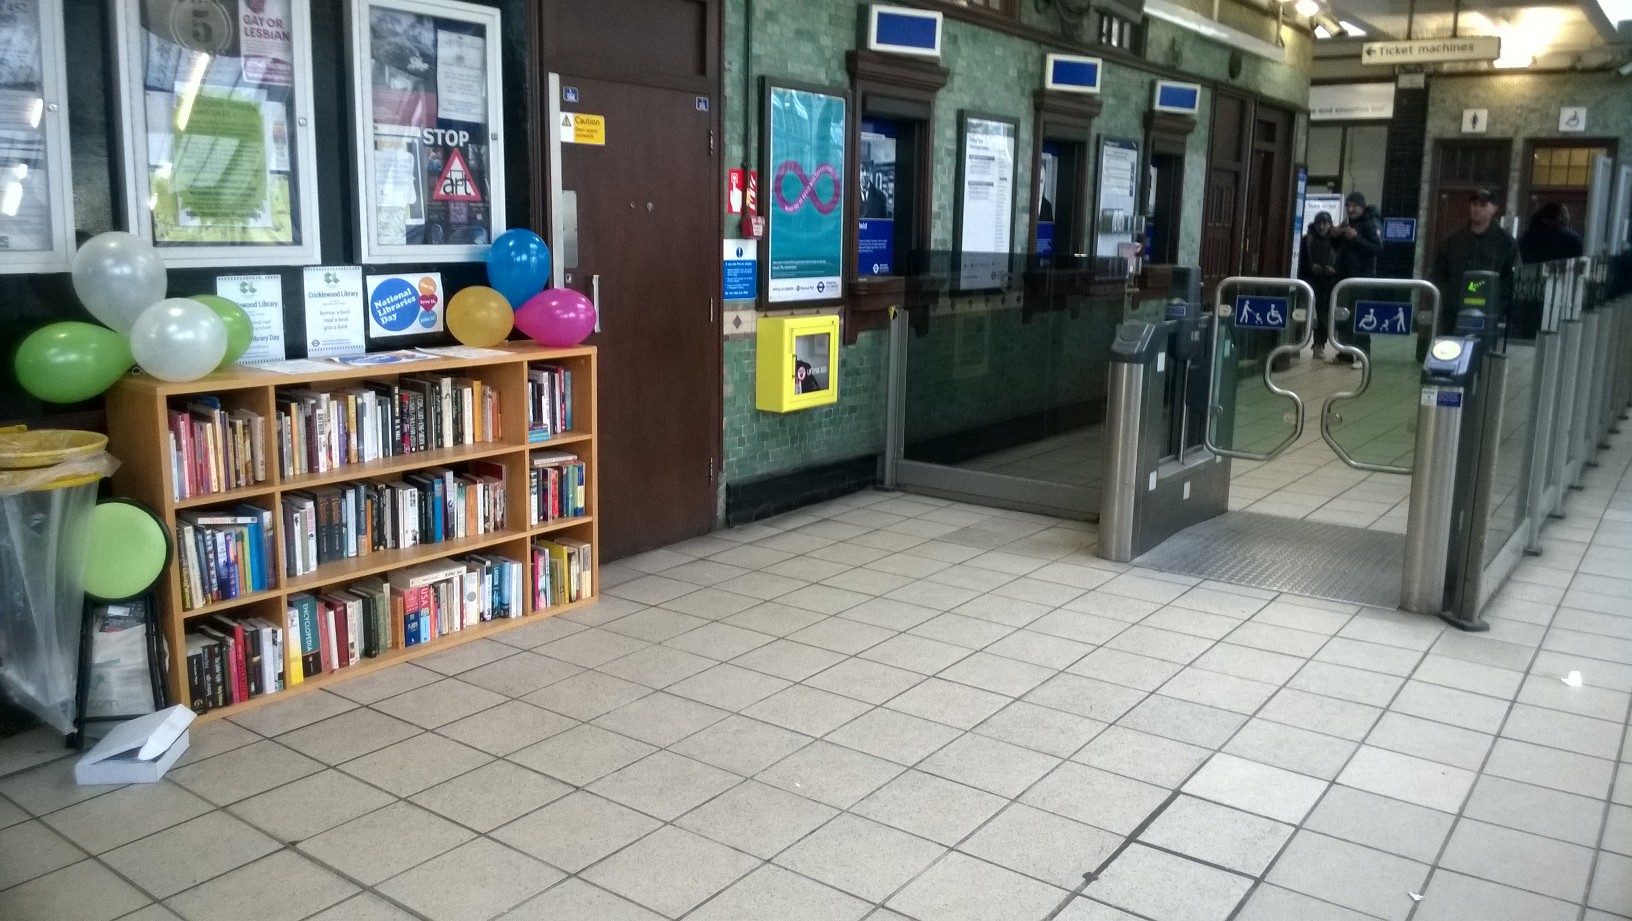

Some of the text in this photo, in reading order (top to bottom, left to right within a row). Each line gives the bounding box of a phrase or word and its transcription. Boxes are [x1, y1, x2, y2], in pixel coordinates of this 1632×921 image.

[243, 14, 284, 29] GAY OR
[244, 26, 291, 42] LESBIAN
[1379, 42, 1474, 56] Ticket machines
[574, 116, 601, 126] Caution
[422, 128, 470, 147] STOP
[442, 175, 472, 196] art
[308, 289, 359, 299] Cricklewood Library
[373, 287, 412, 310] National
[258, 300, 279, 309] Library
[377, 295, 416, 318] Libraries
[380, 312, 398, 325] Day
[269, 334, 280, 343] Day
[420, 587, 429, 607] USA
[302, 603, 313, 652] ENCYCLOPEDIA
